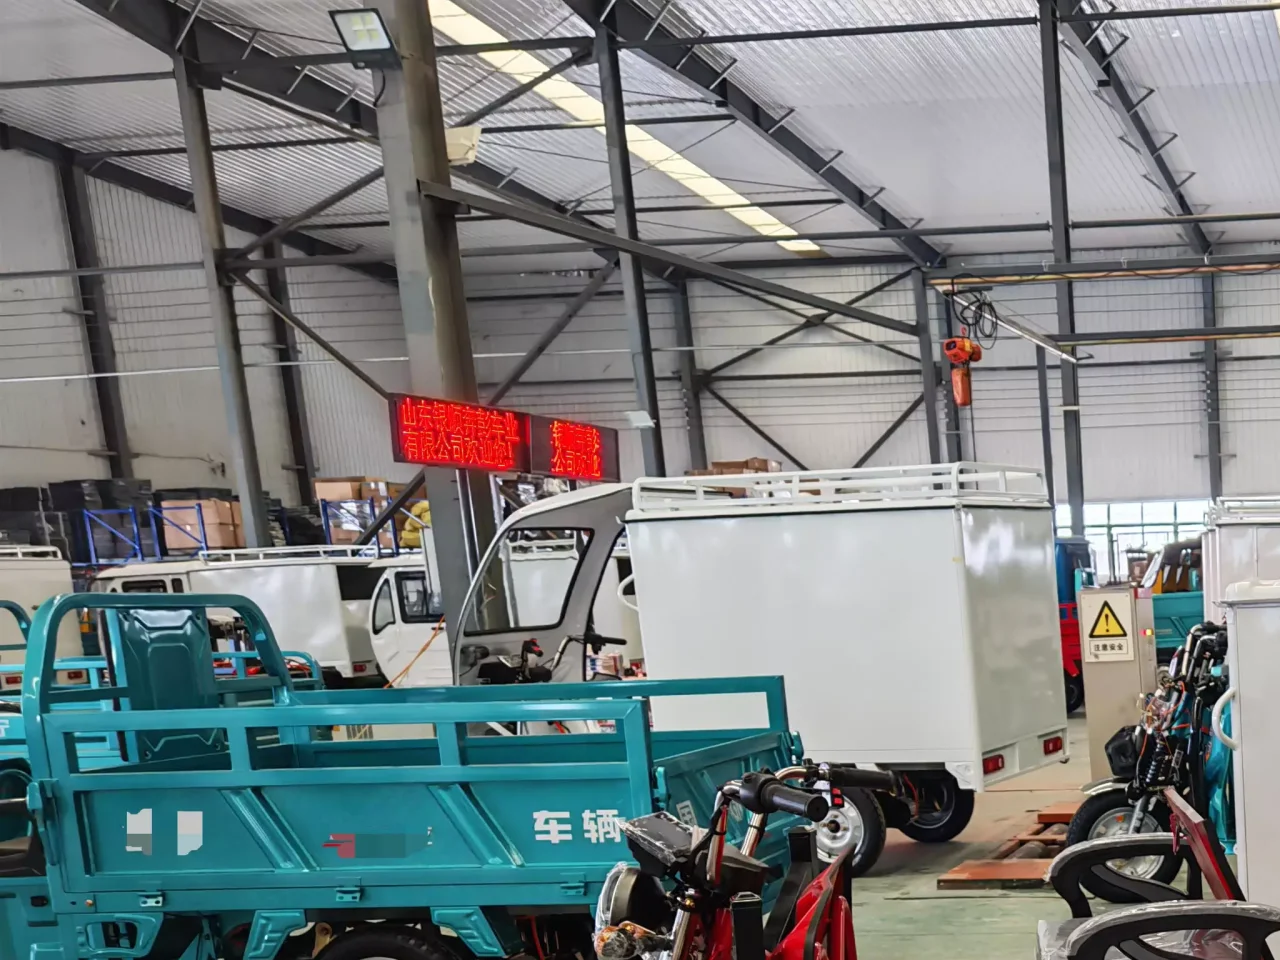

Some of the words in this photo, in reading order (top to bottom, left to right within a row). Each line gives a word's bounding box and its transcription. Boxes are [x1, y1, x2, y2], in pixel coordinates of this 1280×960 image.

[1093, 643, 1124, 652] 注意安全
[533, 809, 625, 844] 车辆
